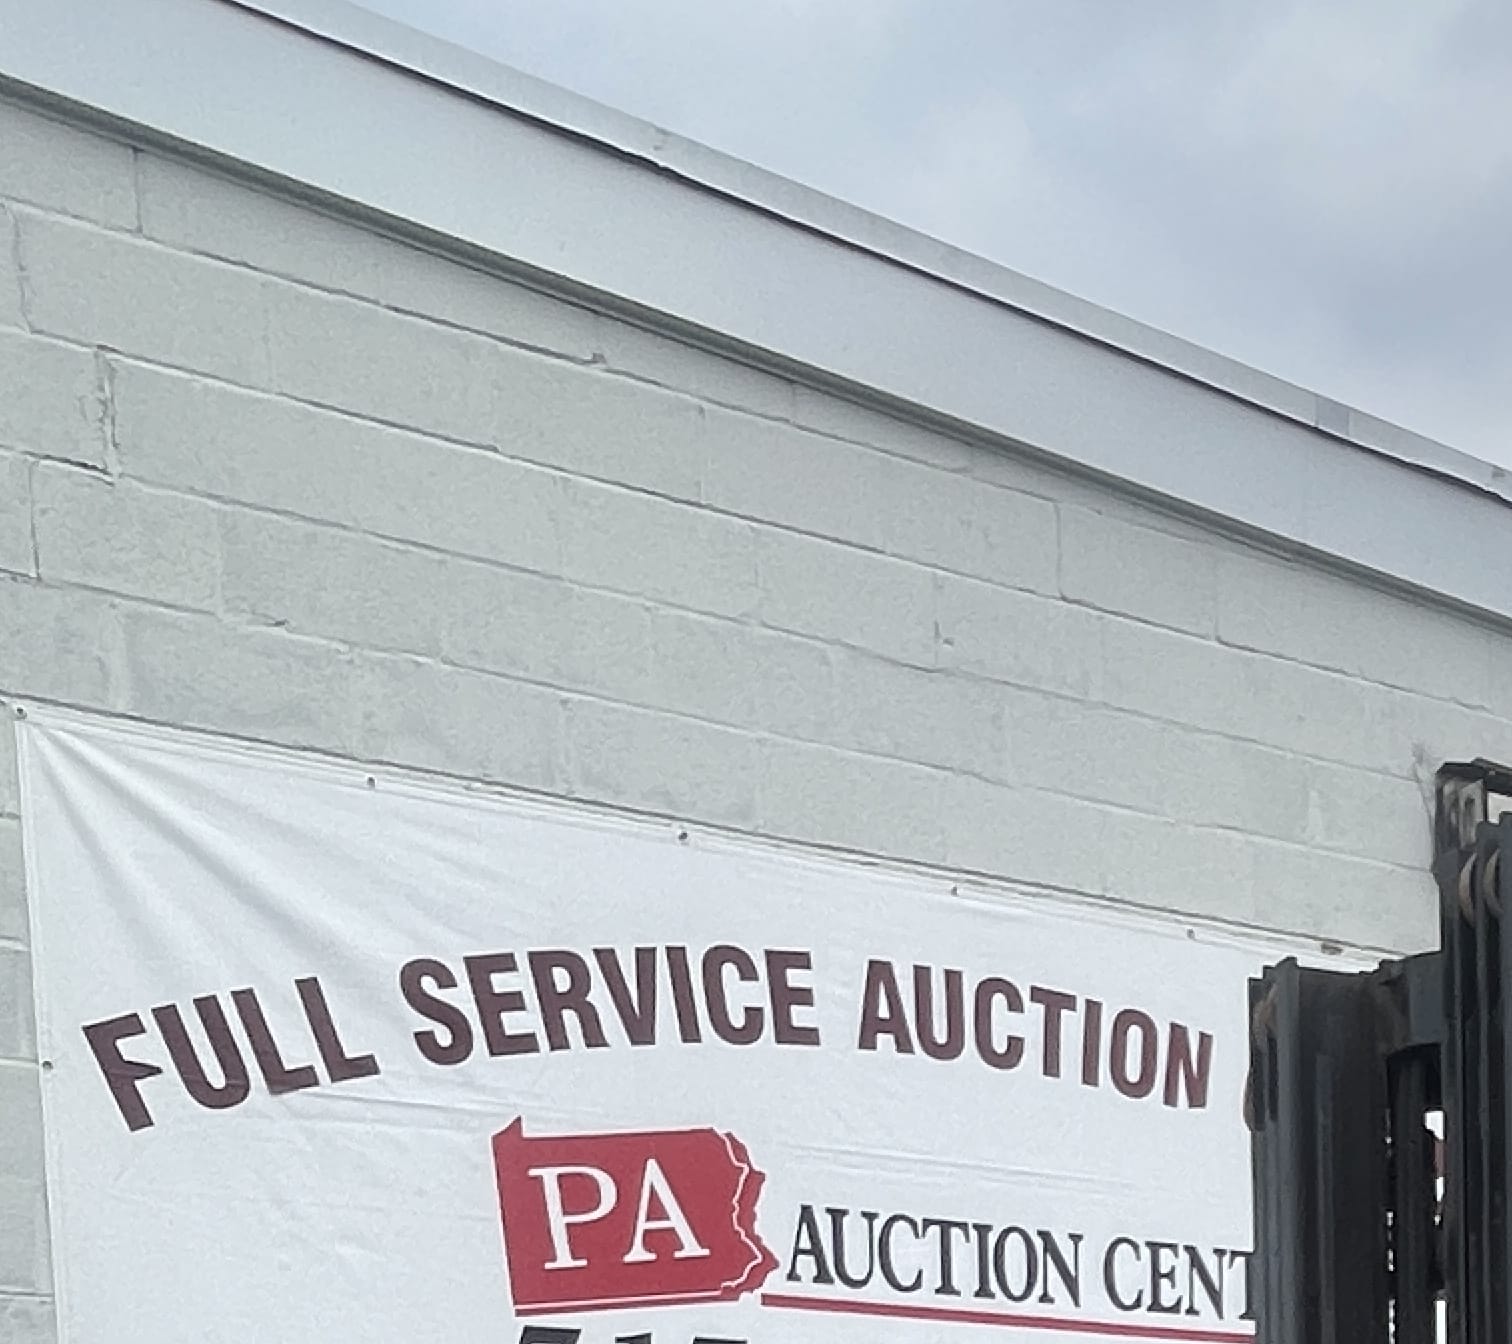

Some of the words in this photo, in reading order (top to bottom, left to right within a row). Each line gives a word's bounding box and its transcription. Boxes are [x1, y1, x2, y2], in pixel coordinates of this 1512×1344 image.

[82, 976, 380, 1132] FULL
[400, 944, 820, 1066] SERVICE
[858, 959, 1213, 1108] AUCTION
[527, 1158, 710, 1270] PA
[787, 1204, 1083, 1308] AUCTION
